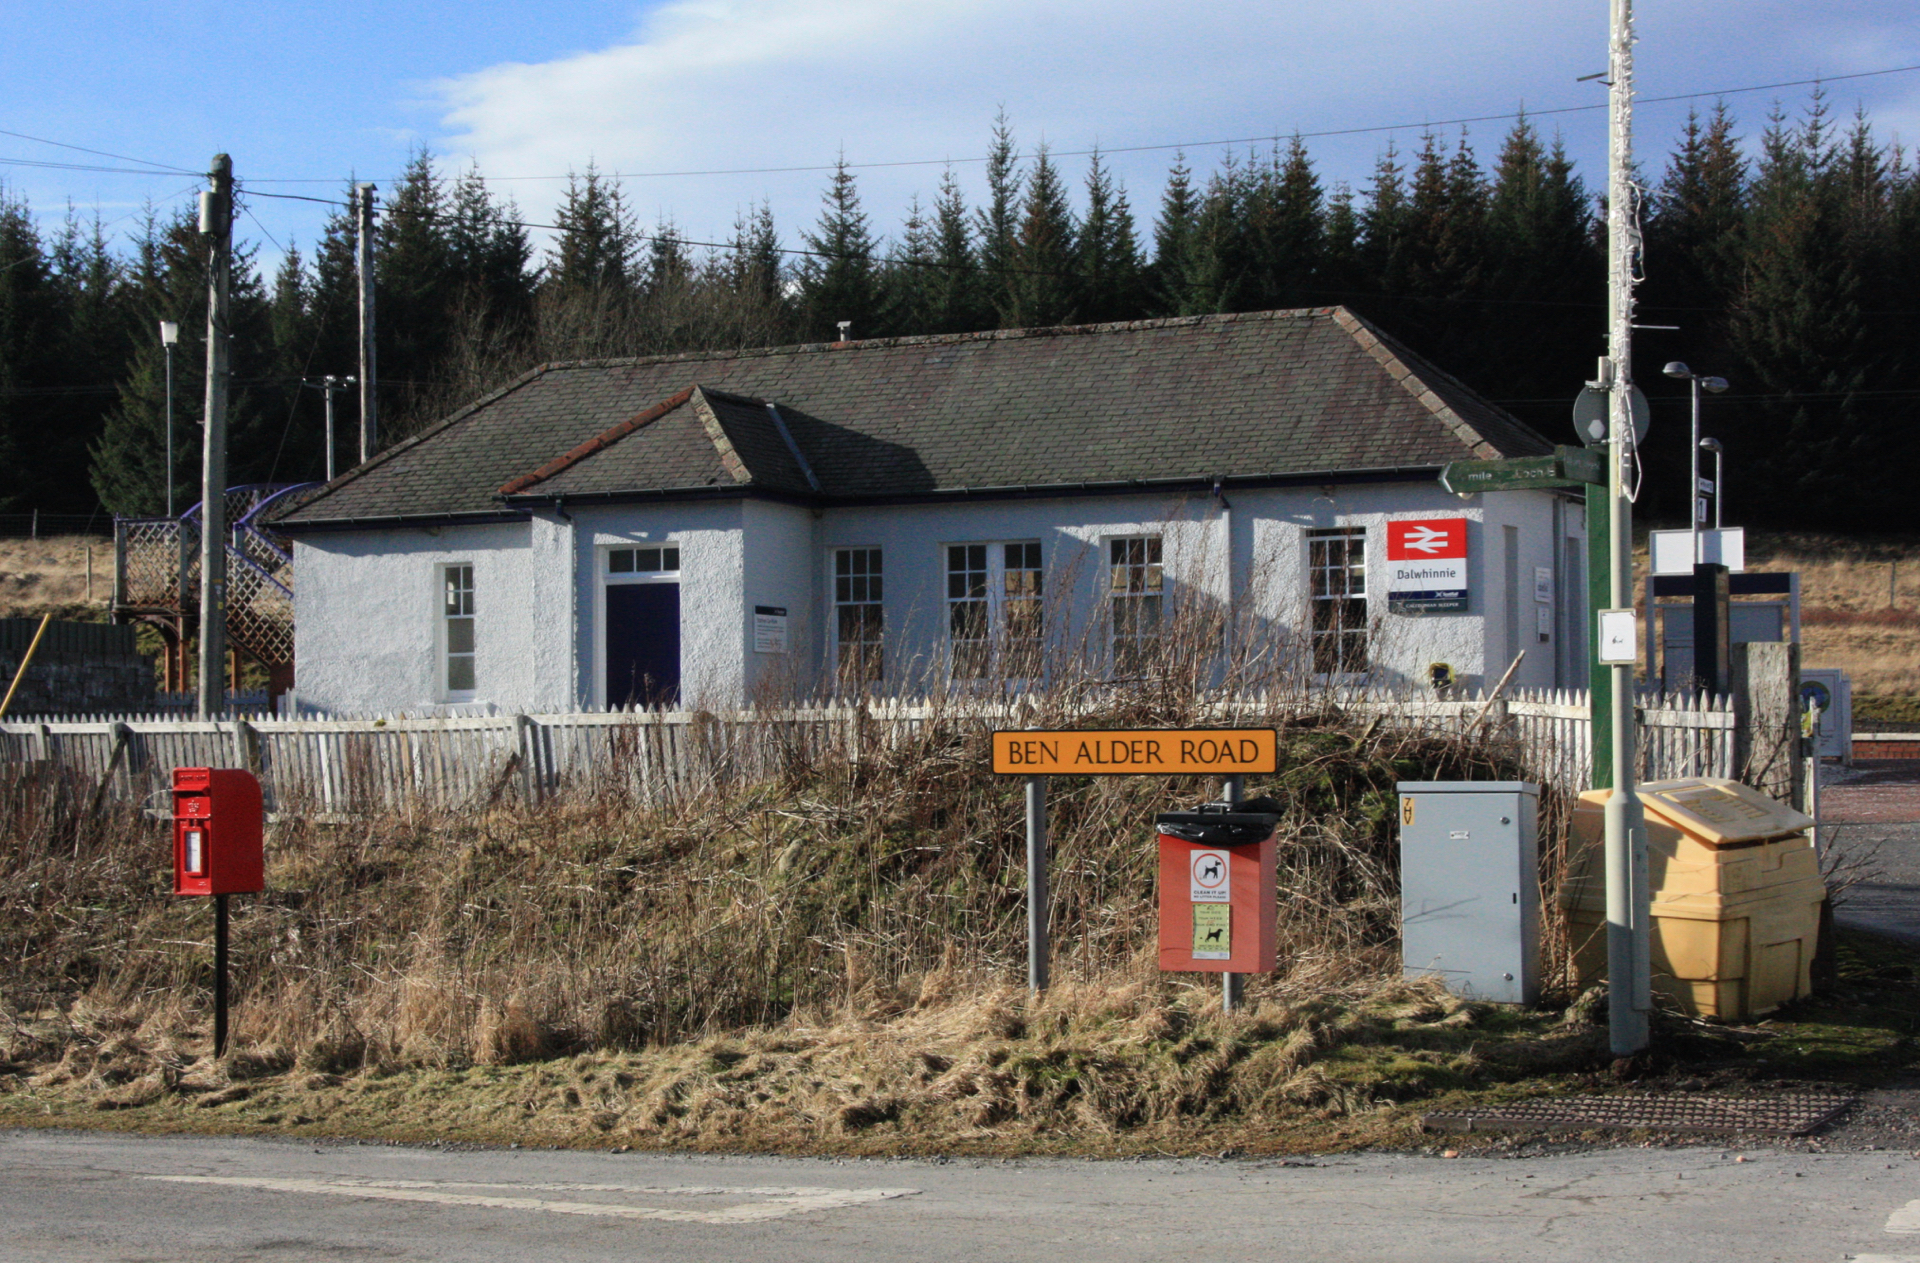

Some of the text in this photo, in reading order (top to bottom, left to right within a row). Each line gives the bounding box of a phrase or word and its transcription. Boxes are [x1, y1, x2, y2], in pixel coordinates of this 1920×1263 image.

[1468, 471, 1493, 481] mile
[1397, 568, 1456, 580] Dalwhinnie
[1008, 739, 1259, 765] BEN ALDER ROAD
